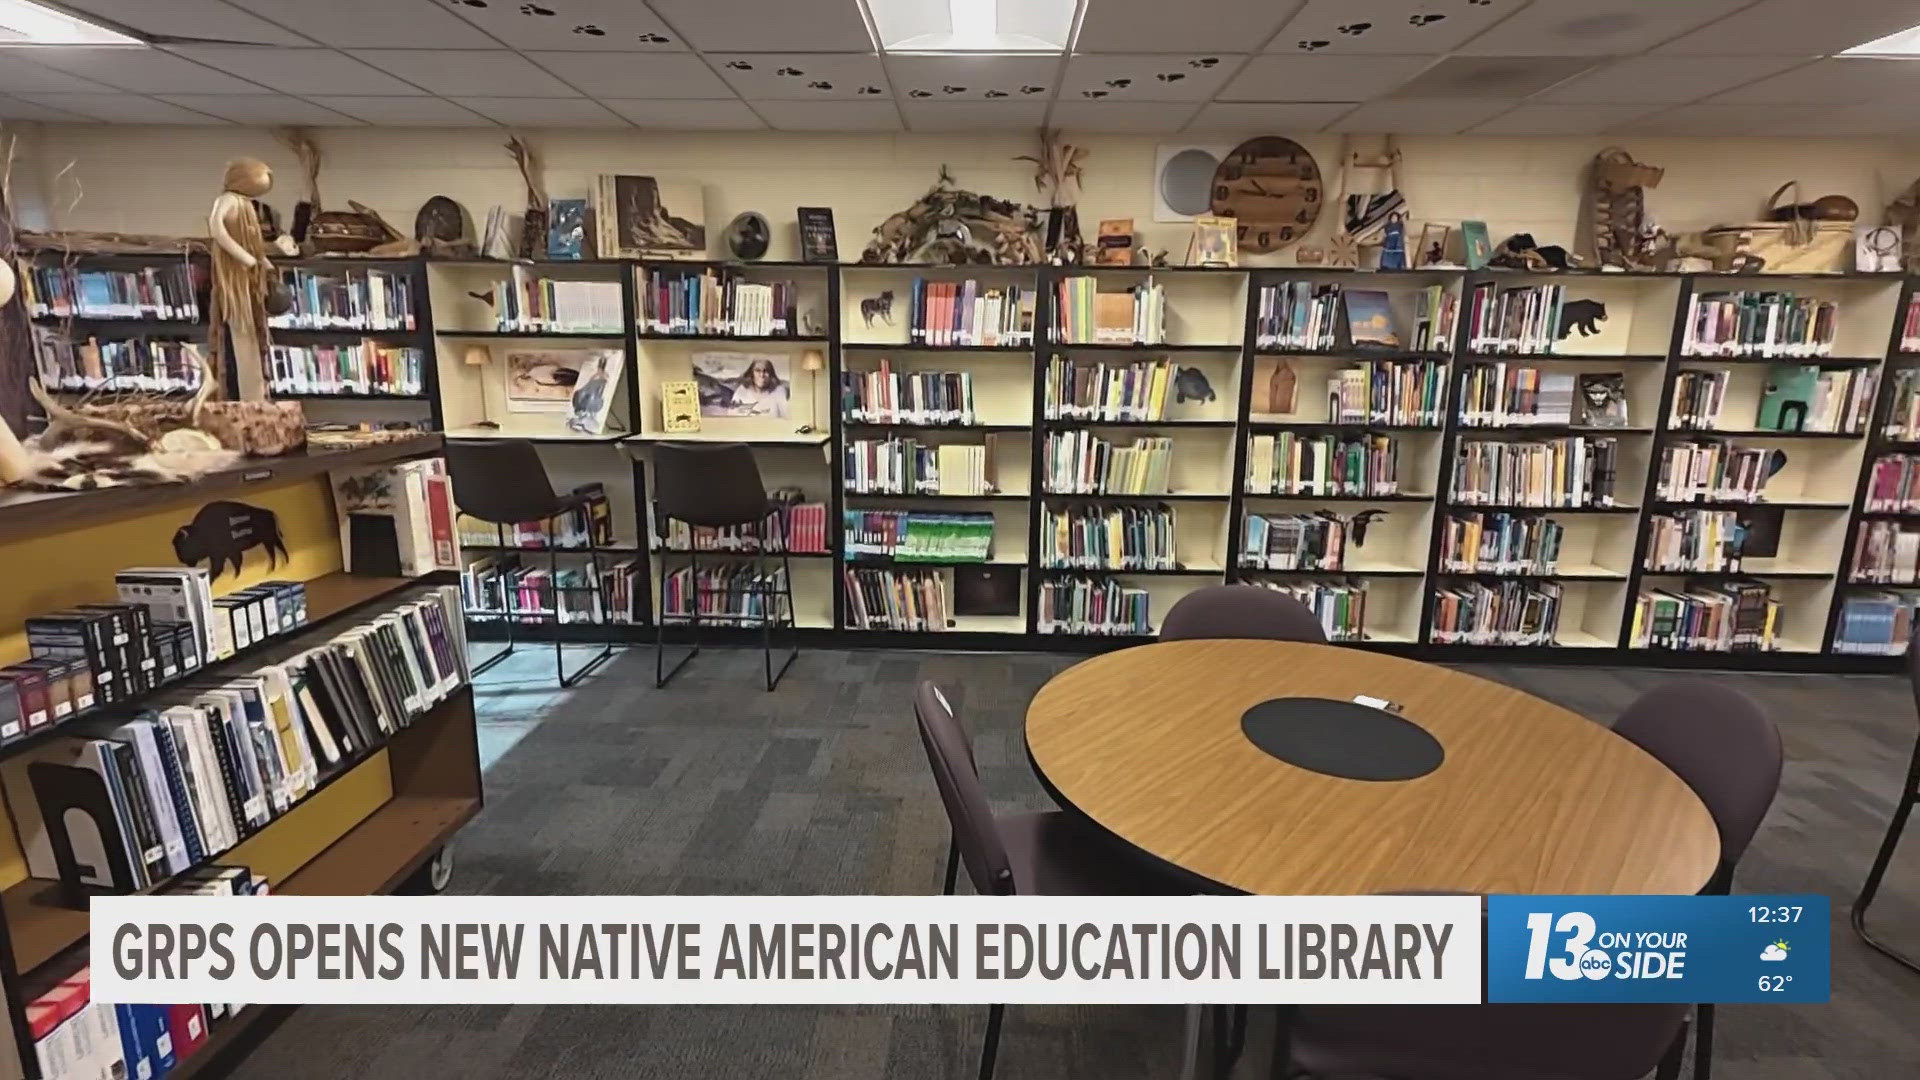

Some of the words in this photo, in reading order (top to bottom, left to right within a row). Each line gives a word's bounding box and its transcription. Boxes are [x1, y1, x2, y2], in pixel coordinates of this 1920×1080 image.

[1304, 187, 1318, 203] 3
[1295, 208, 1309, 225] 4
[1237, 225, 1249, 241] 7
